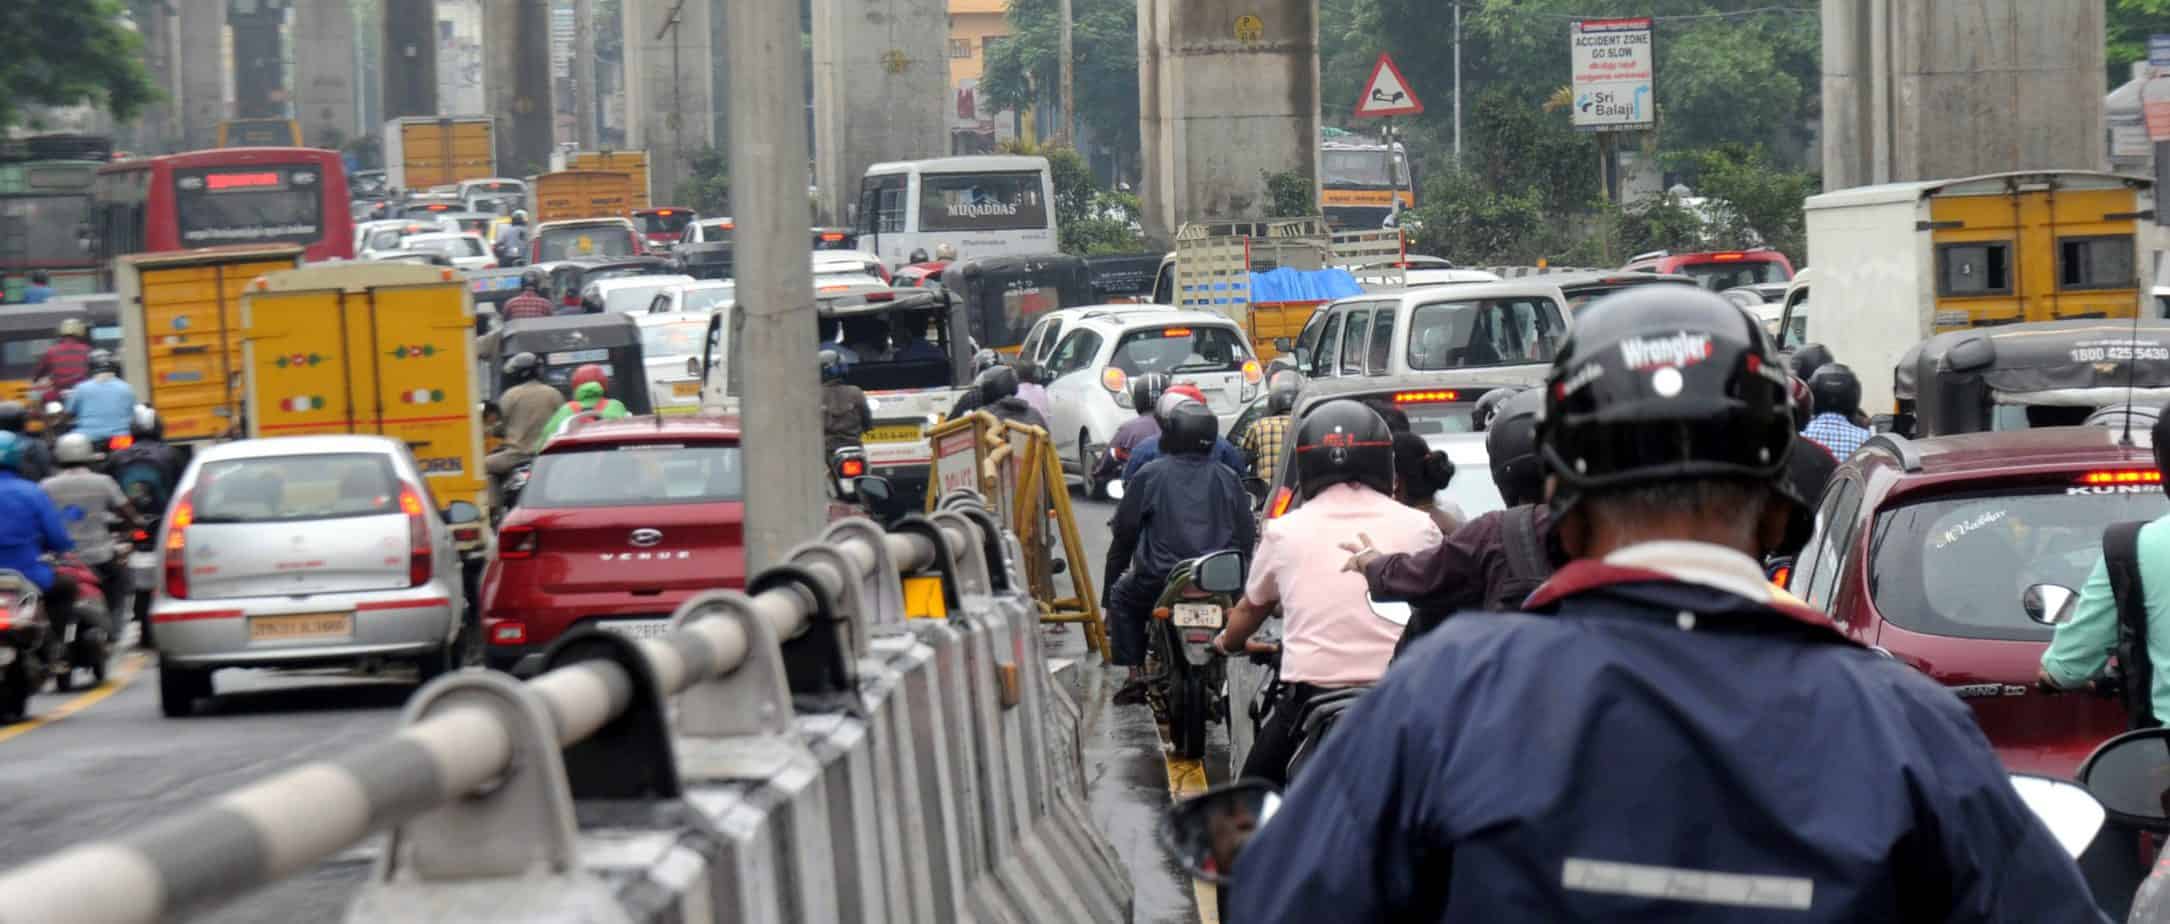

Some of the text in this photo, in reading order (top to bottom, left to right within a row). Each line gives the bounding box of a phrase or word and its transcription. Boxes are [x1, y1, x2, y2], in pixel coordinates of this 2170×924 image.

[1576, 34, 1648, 47] ACCIDENT ZONE
[1592, 47, 1633, 59] GO SLOW
[1595, 91, 1614, 104] Sri
[1595, 103, 1634, 120] Balaji
[947, 203, 1018, 218] MUQADDAS
[1621, 331, 1712, 370] Wrangler
[2071, 347, 2105, 362] 1800
[2107, 346, 2133, 360] 425
[599, 551, 690, 561] VENUE
